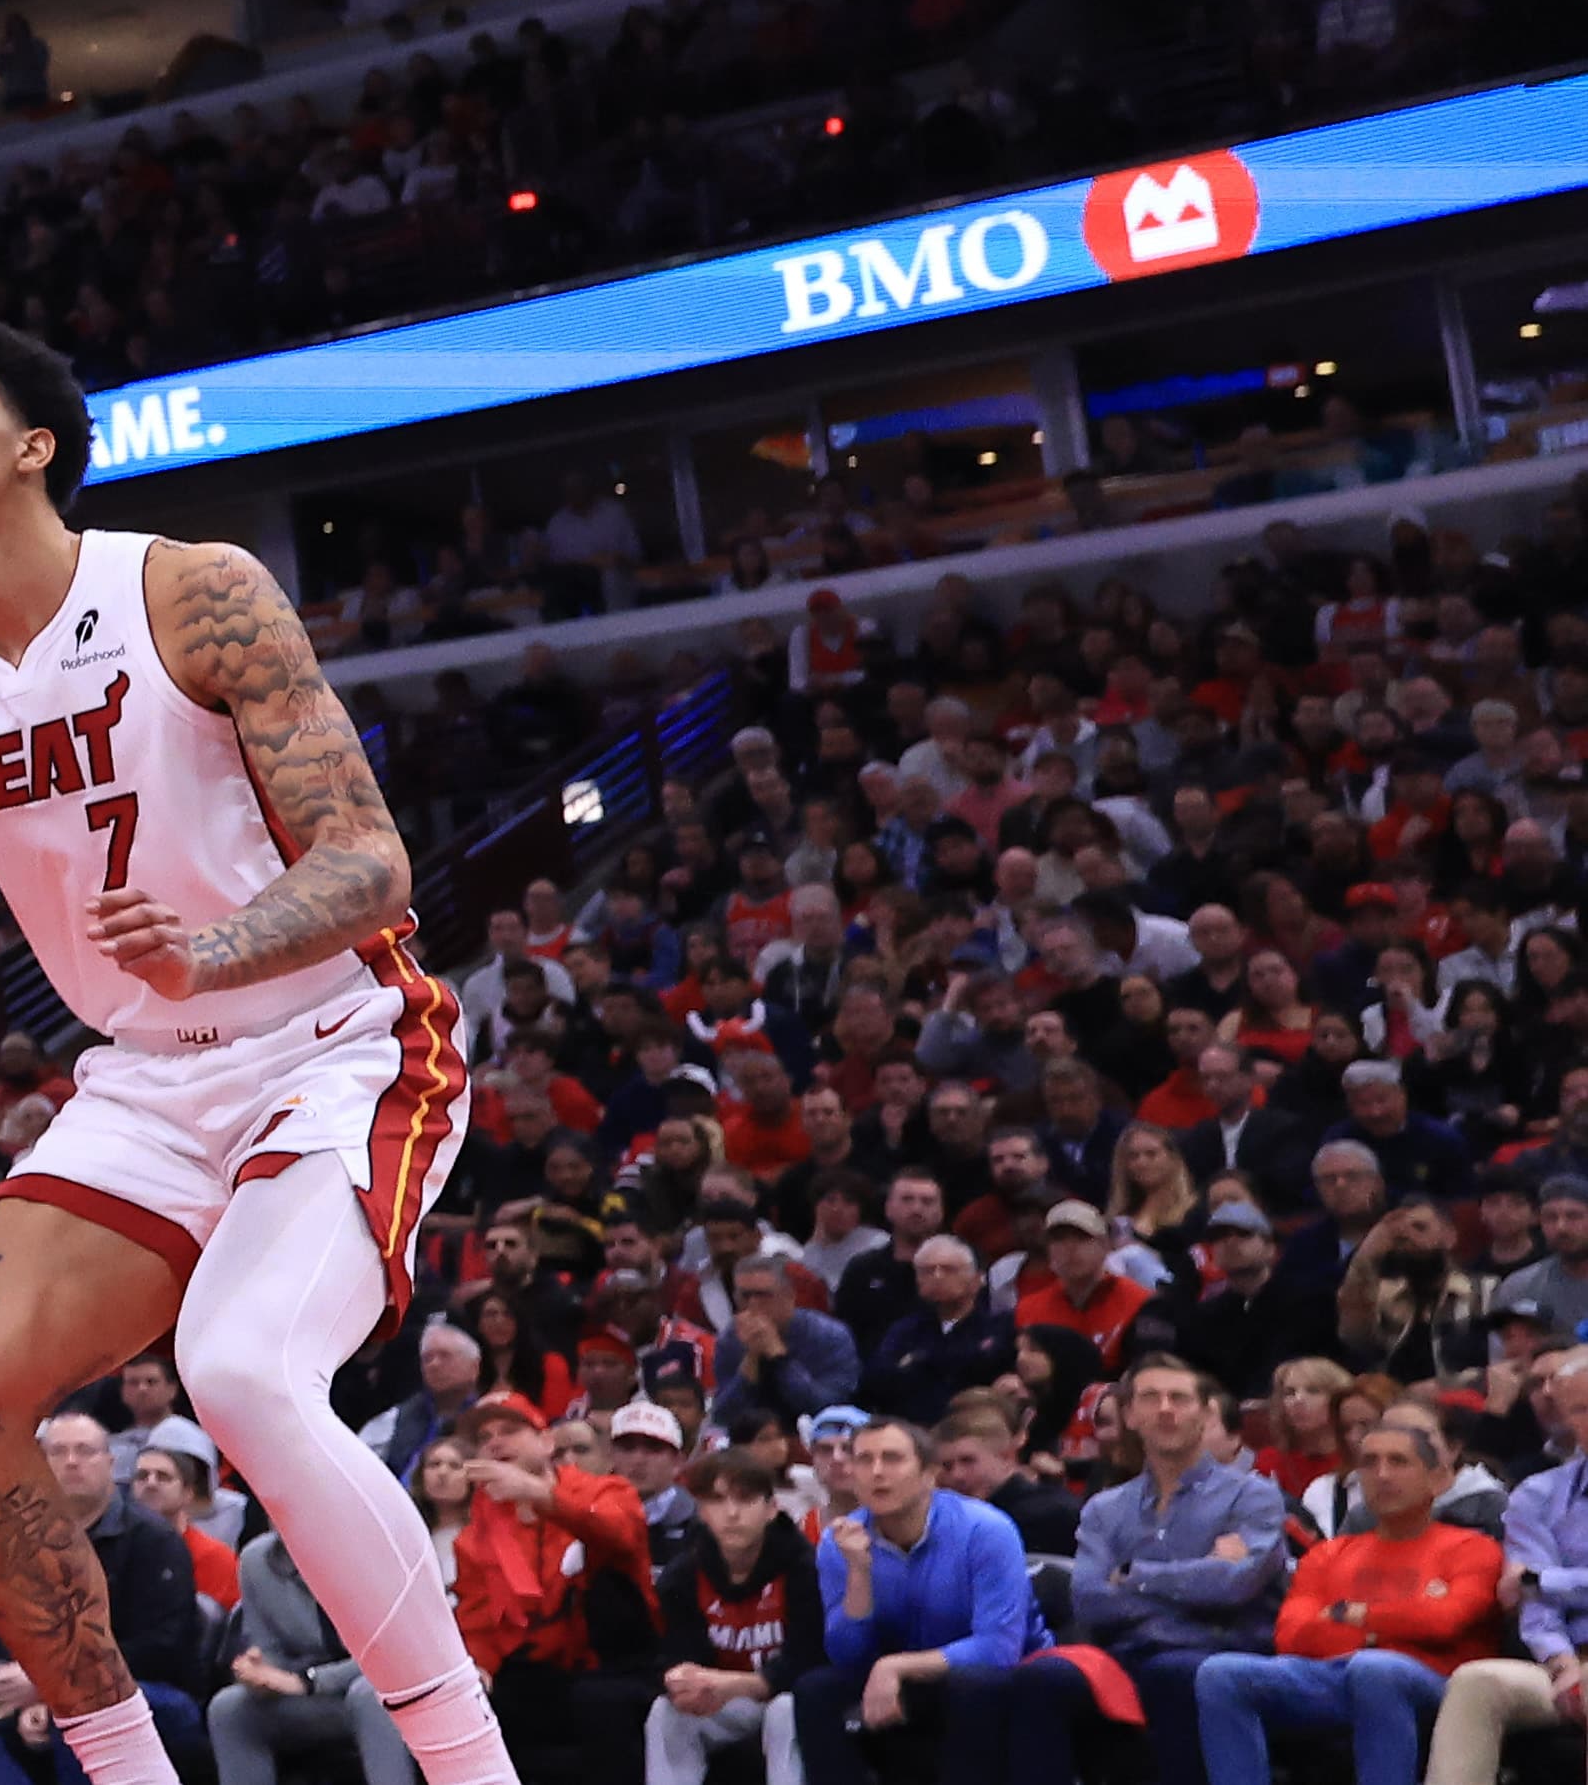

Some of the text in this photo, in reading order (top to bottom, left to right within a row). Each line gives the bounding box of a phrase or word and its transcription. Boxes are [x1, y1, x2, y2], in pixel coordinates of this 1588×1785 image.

[773, 210, 1049, 334] BMO
[60, 643, 126, 671] Robinhood
[85, 790, 140, 893] 7
